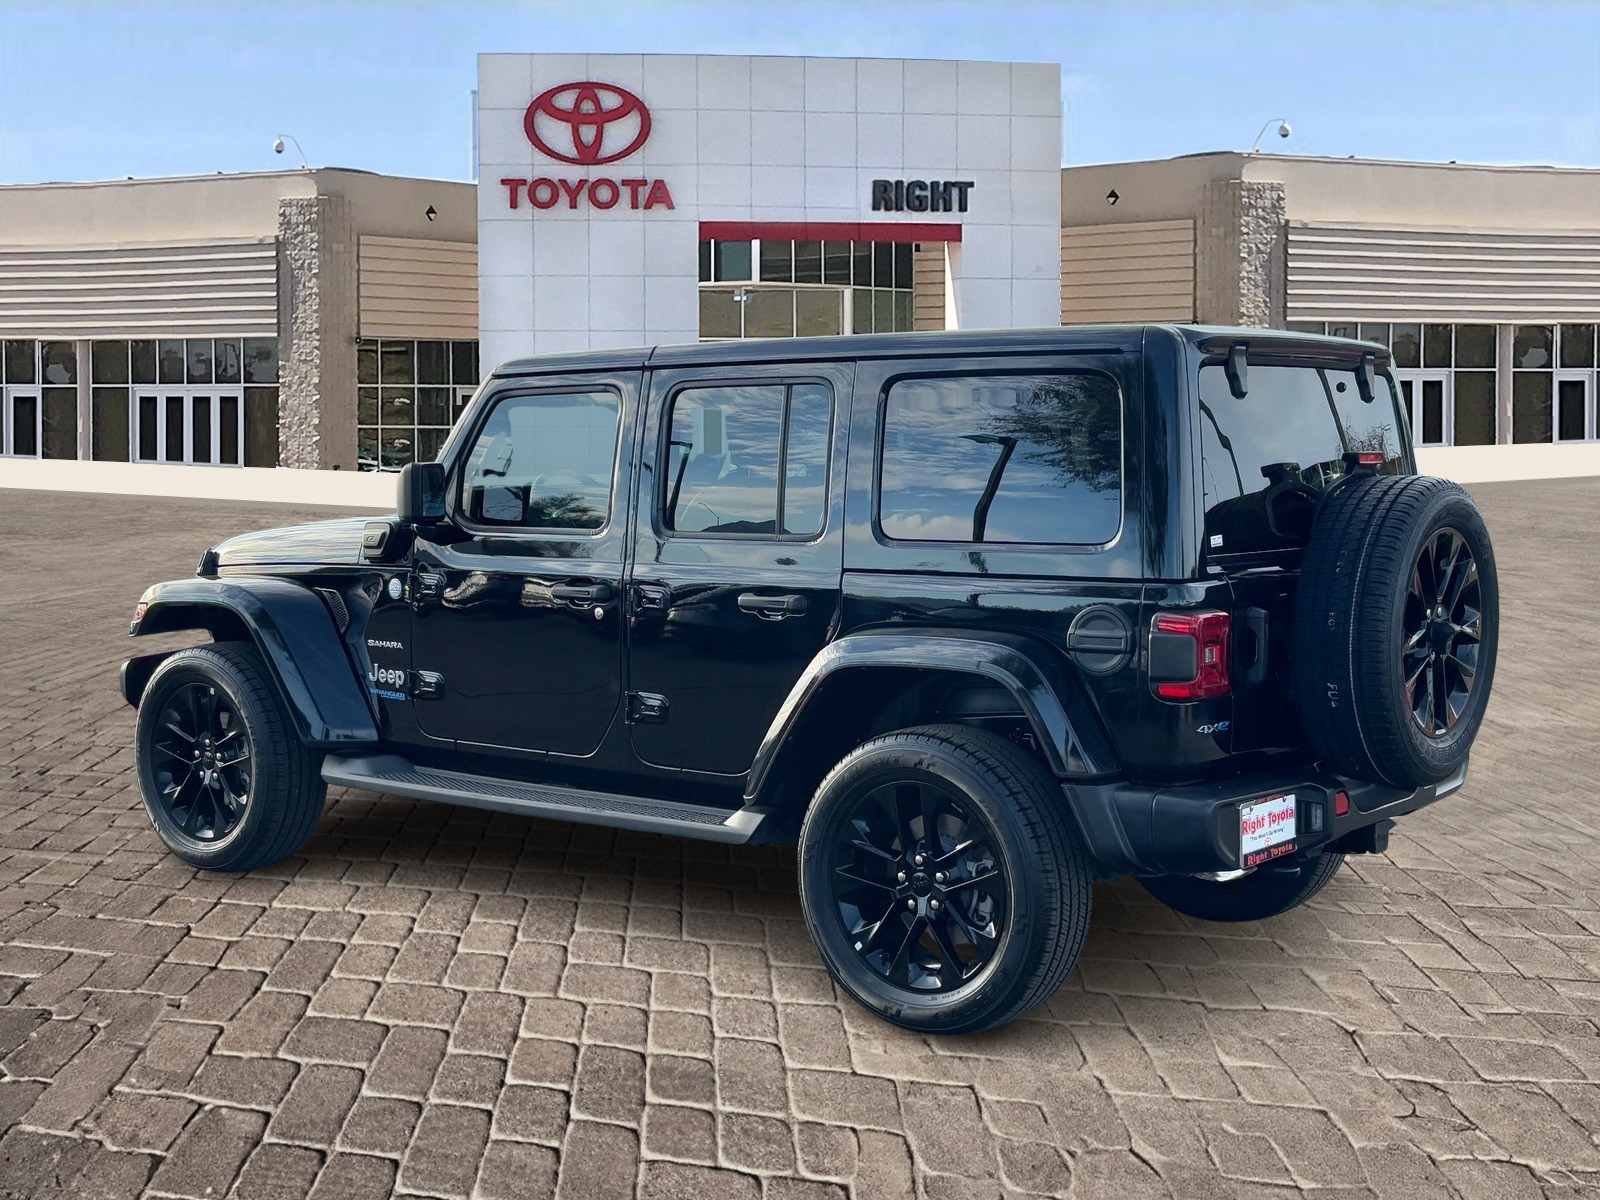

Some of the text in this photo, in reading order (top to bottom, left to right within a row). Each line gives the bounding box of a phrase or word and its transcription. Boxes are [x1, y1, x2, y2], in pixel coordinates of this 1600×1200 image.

[500, 178, 675, 210] TOYOTA
[872, 180, 975, 213] RIGHT
[367, 639, 404, 650] SAHARA
[368, 663, 405, 688] Jeep
[1242, 807, 1295, 835] Right Toyota
[1248, 844, 1293, 865] Right Toyota
